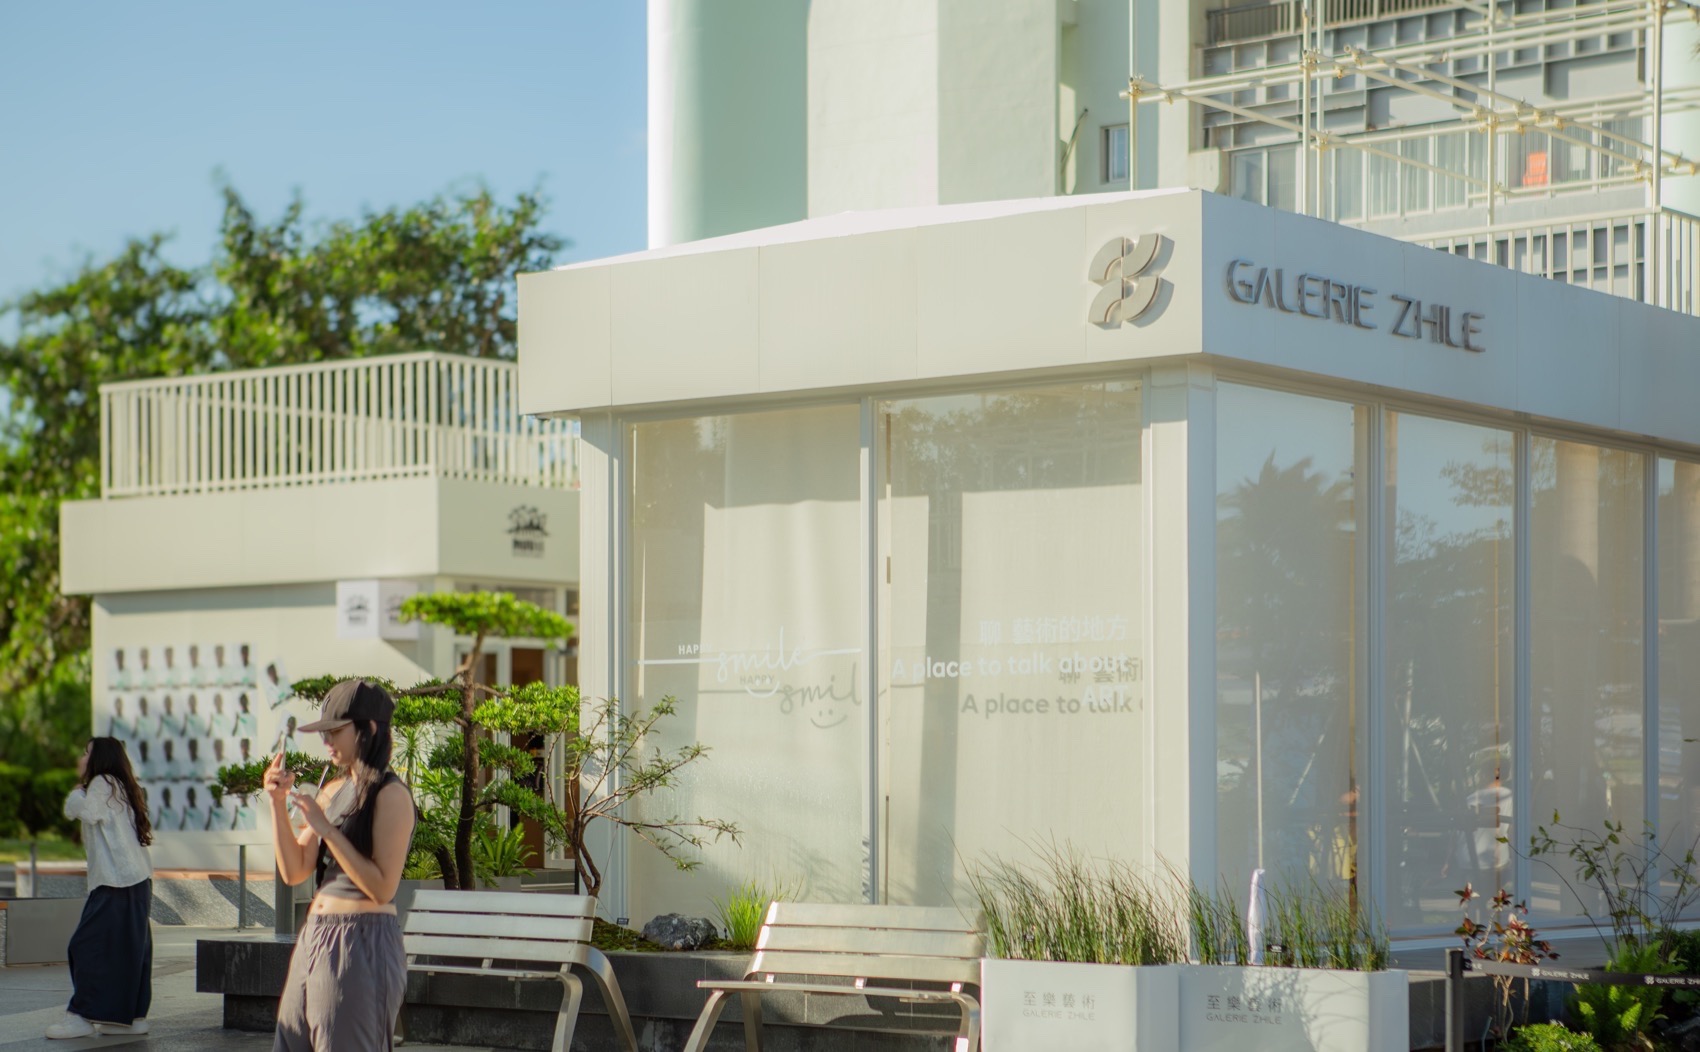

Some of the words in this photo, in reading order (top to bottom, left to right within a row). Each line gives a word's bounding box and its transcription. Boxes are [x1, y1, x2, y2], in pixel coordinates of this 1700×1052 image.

[1226, 259, 1378, 329] GALERIE
[1390, 294, 1486, 353] ZHILE
[892, 658, 907, 679] A
[912, 656, 974, 684] place
[978, 656, 1003, 678] to
[1007, 652, 1054, 676] talk
[1058, 650, 1128, 673] about
[961, 693, 980, 715] A
[984, 691, 1050, 720] place
[1056, 695, 1081, 715] to
[1023, 991, 1096, 1010] 至樂藝術
[1022, 1009, 1063, 1020] GALERIE
[1067, 1010, 1096, 1021] ZHILE
[1206, 1012, 1249, 1024] GALERIE
[1252, 1014, 1283, 1025] ZHILE
